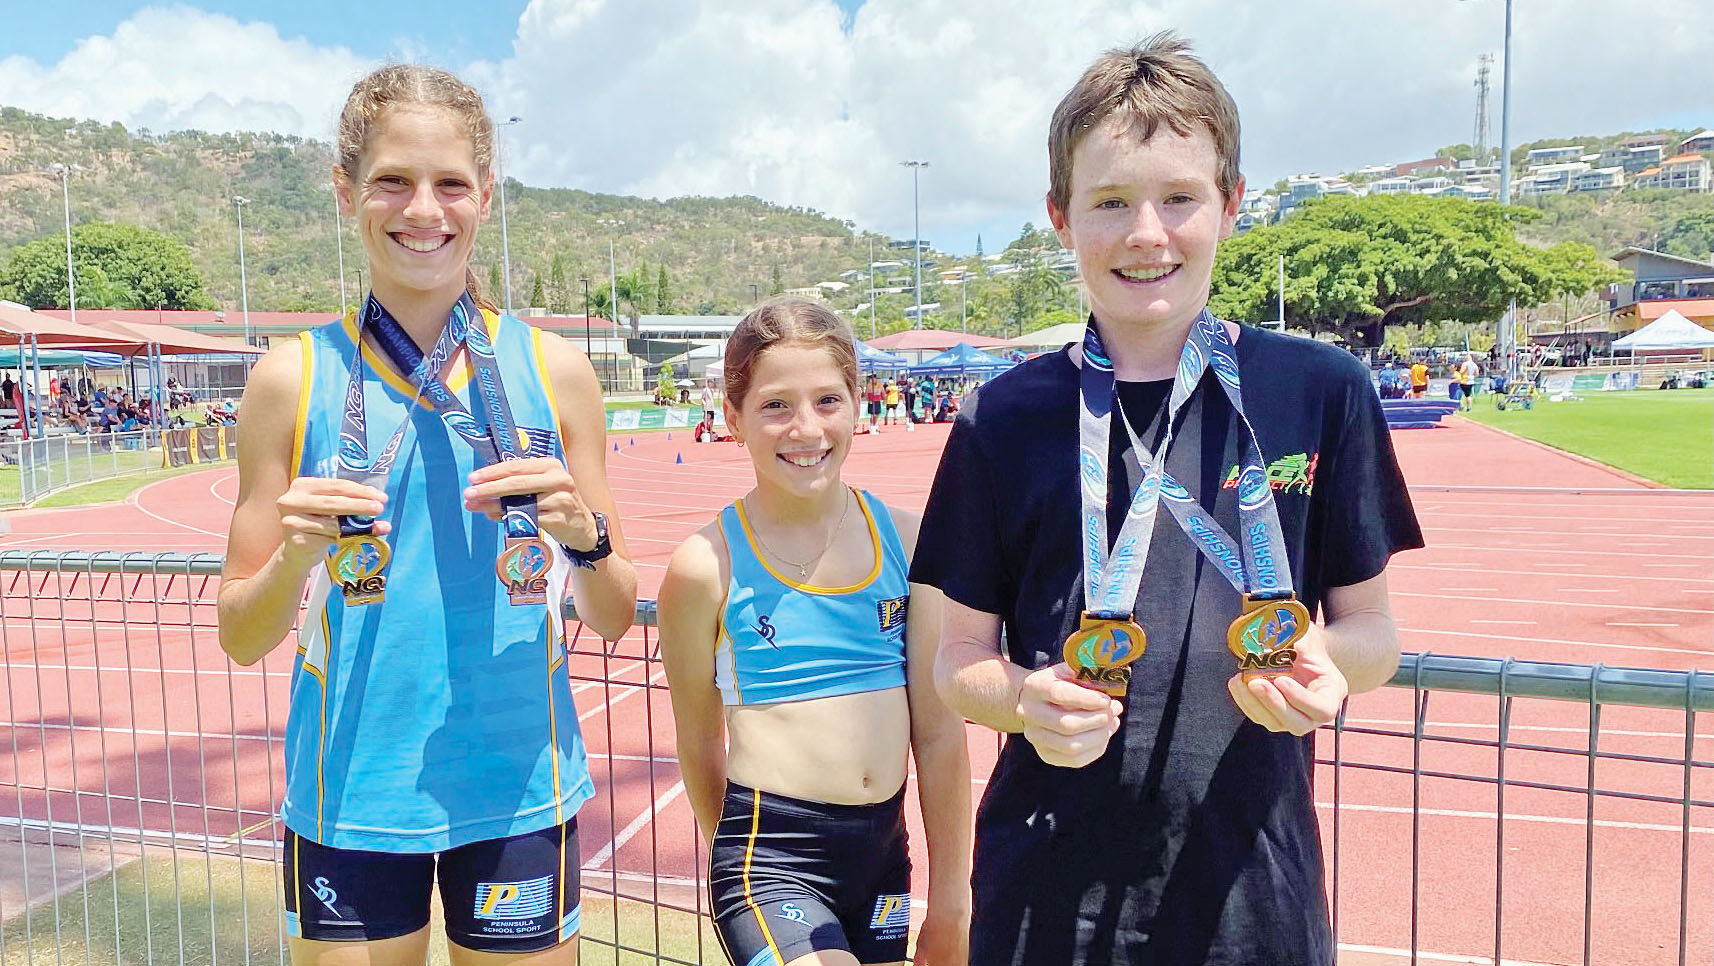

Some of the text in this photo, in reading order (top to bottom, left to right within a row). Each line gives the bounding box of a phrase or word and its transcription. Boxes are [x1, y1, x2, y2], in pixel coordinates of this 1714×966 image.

[480, 367, 515, 452] CHAMPIONSHIPS
[478, 884, 521, 915] P
[876, 896, 902, 924] P
[483, 924, 541, 934] SCHOOL SPORT
